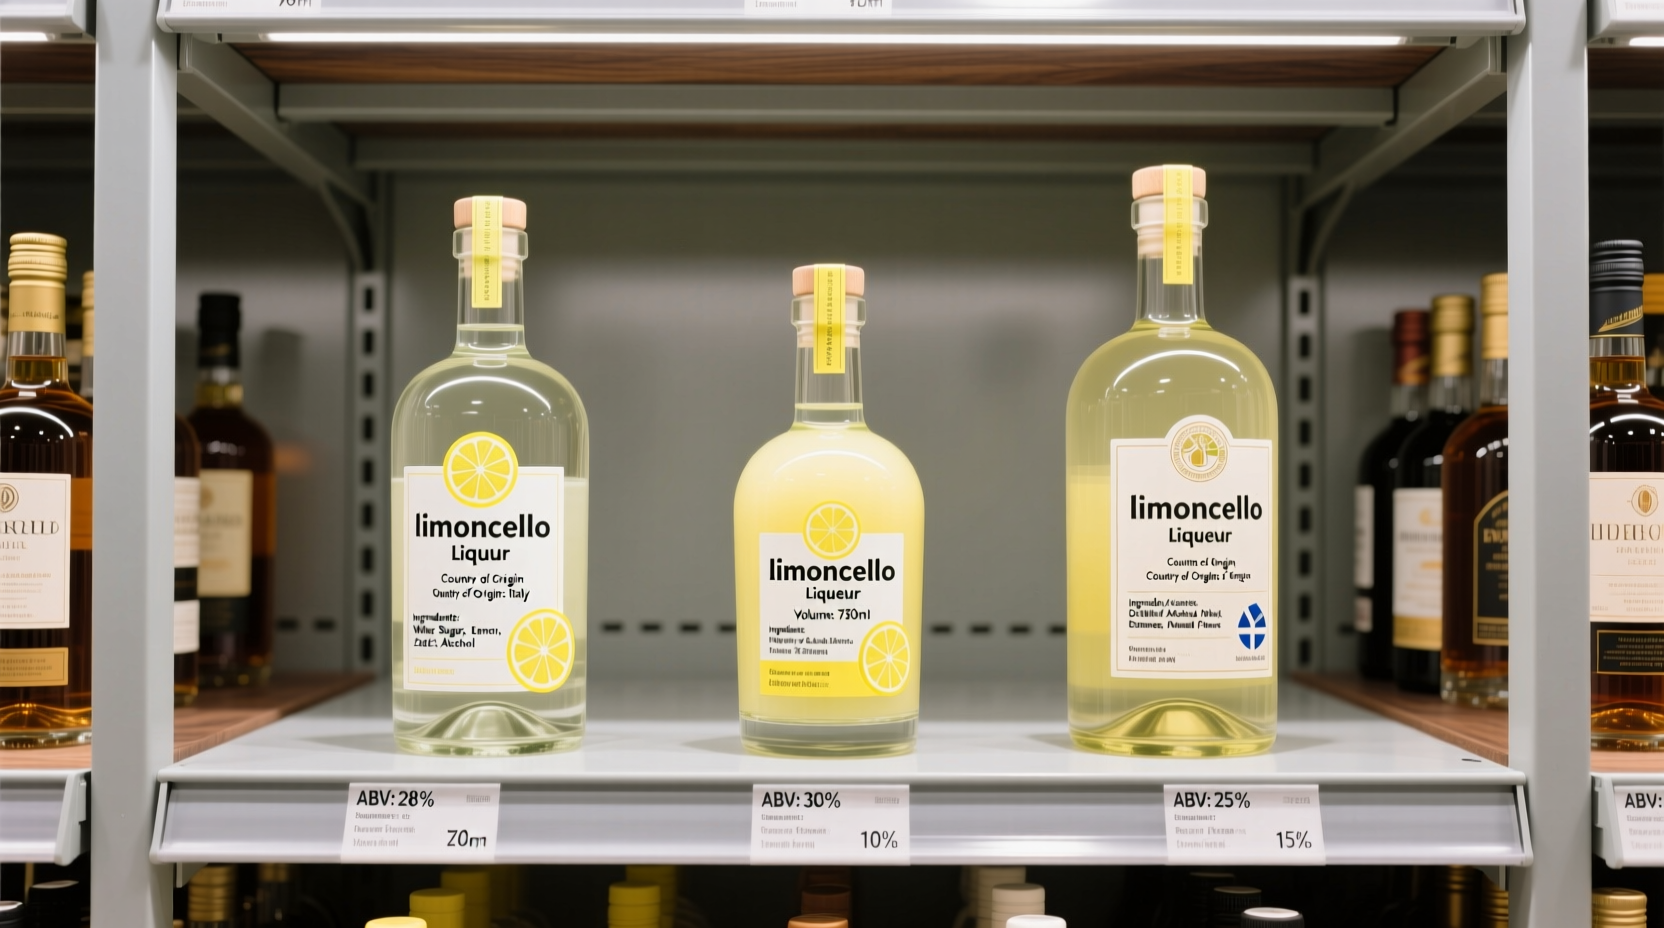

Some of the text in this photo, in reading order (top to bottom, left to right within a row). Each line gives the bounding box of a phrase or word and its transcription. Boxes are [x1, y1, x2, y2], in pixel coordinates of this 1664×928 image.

[1130, 494, 1263, 520] limoncello
[415, 512, 551, 538] limoncello
[1169, 527, 1232, 548] Liqueur
[451, 544, 510, 566] Liquur
[769, 558, 896, 582] limoncello
[806, 586, 861, 604] Liqueur
[356, 790, 435, 808] ABV: 28%
[761, 791, 841, 809] ABV: 30%
[1173, 791, 1251, 809] ABV: 25%
[1624, 792, 1662, 809] ABV:
[861, 830, 898, 849] 10%
[1276, 830, 1312, 849] 15%
